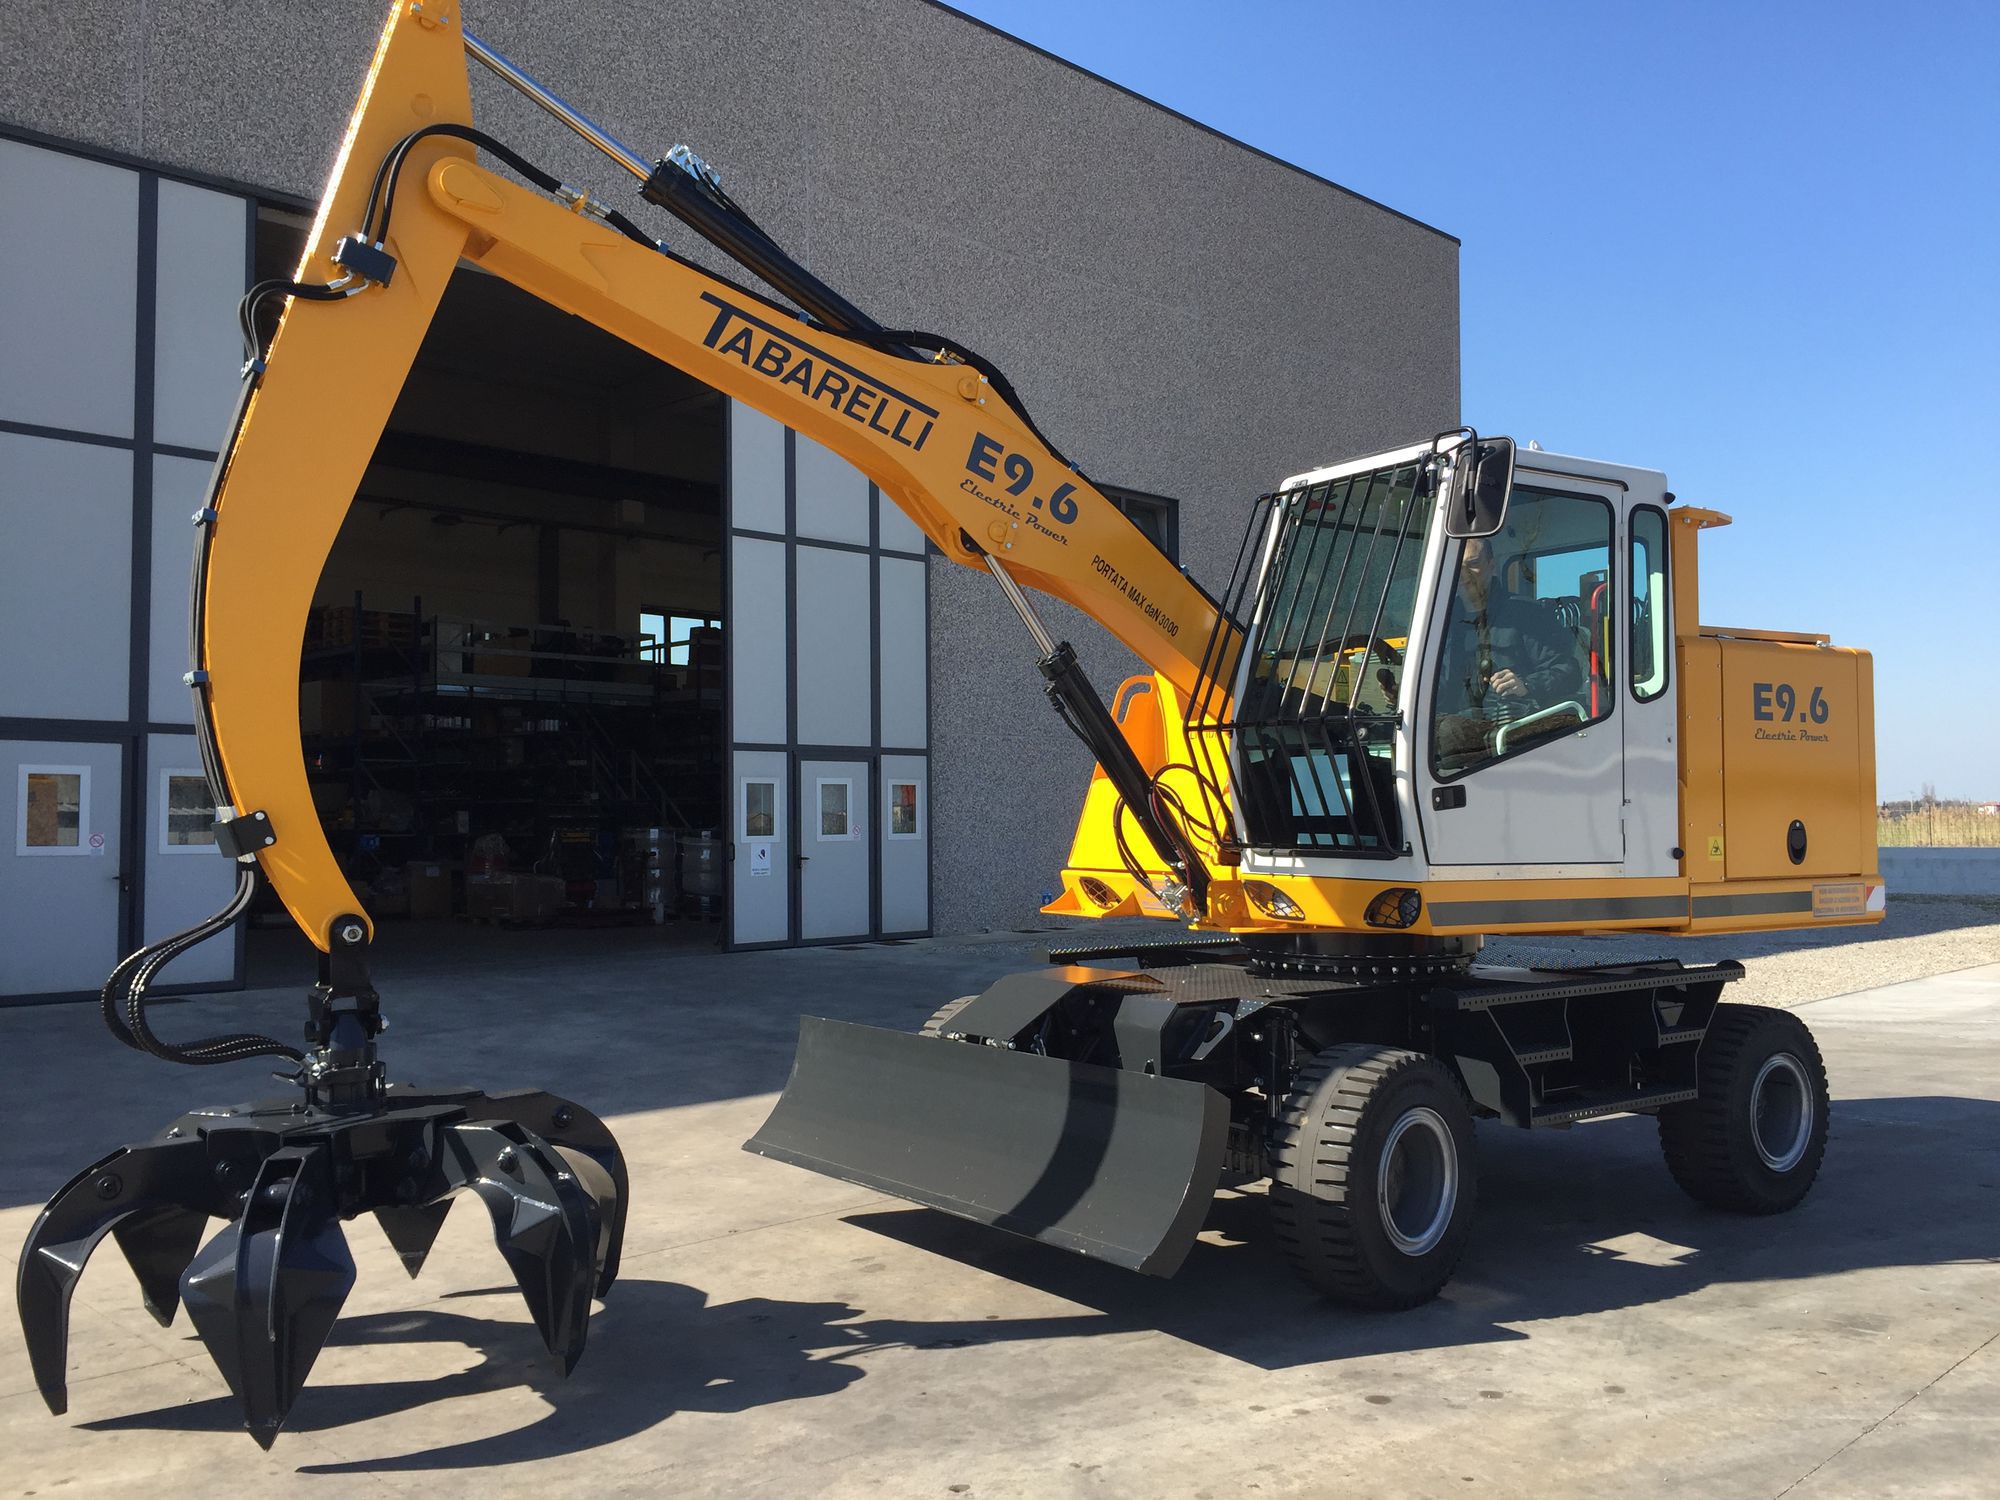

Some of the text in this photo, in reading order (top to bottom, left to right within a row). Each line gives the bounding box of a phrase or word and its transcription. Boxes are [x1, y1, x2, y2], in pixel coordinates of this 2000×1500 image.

[700, 291, 940, 451] TABARELLI
[965, 431, 1079, 525] E9.6
[959, 478, 1069, 546] Electric Power
[1091, 554, 1129, 594] PORTATA
[1126, 586, 1148, 609] MAX
[1753, 683, 1829, 724] E9.6
[1754, 727, 1829, 742] Electric Power
